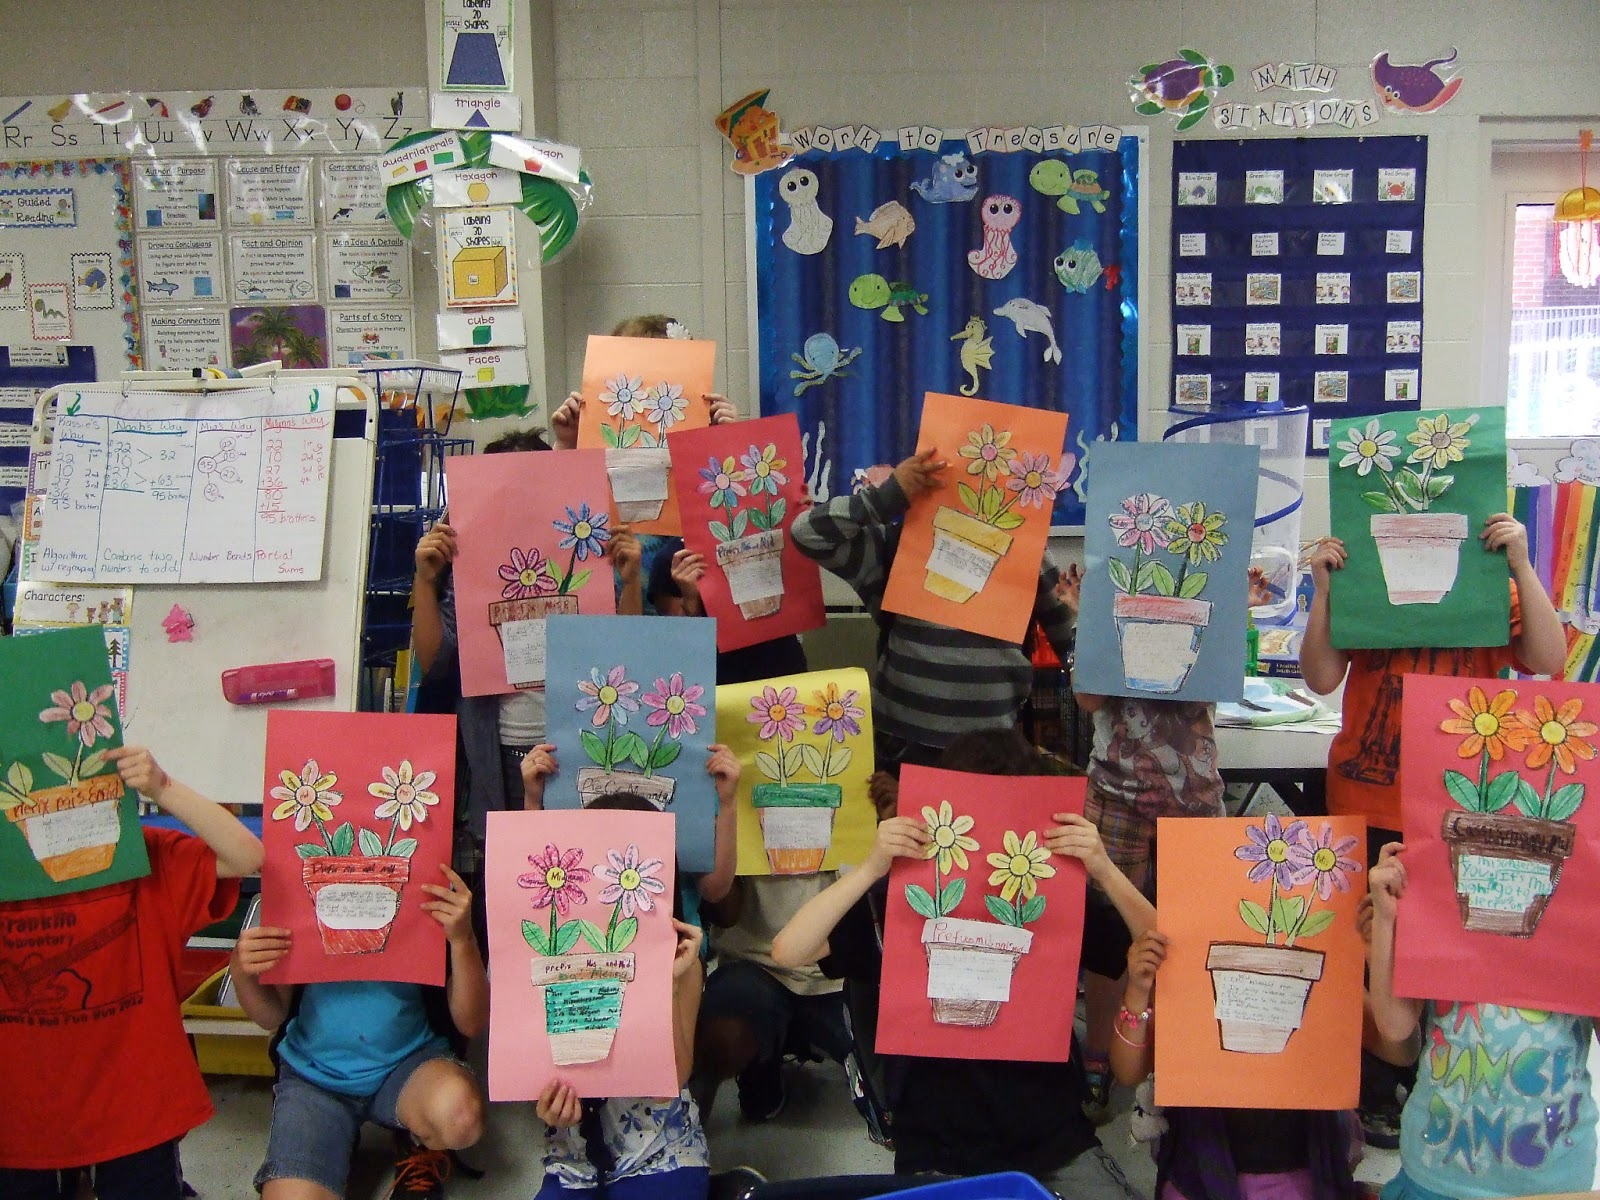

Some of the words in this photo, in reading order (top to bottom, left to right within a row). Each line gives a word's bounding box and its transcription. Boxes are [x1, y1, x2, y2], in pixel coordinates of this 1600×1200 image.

[1259, 68, 1331, 88] MATH
[455, 97, 501, 109] triangle
[1221, 103, 1372, 125] STATIONS
[794, 130, 872, 149] Work
[905, 131, 937, 147] to
[972, 131, 1115, 150] Treasure
[275, 164, 300, 173] Effect
[455, 172, 498, 181] Hexagon
[17, 197, 52, 207] Guided
[16, 212, 54, 224] Reading
[241, 239, 258, 247] Fact
[259, 239, 274, 247] and
[275, 239, 304, 248] Opinion
[377, 238, 404, 247] Details
[151, 318, 176, 326] Making
[178, 317, 221, 325] Connections
[340, 313, 360, 321] Parts
[362, 313, 371, 321] of
[380, 313, 403, 322] Story
[467, 315, 495, 325] cube
[468, 355, 501, 365] Faces
[138, 564, 150, 574] to
[153, 560, 179, 574] add
[24, 590, 86, 602] Characters:
